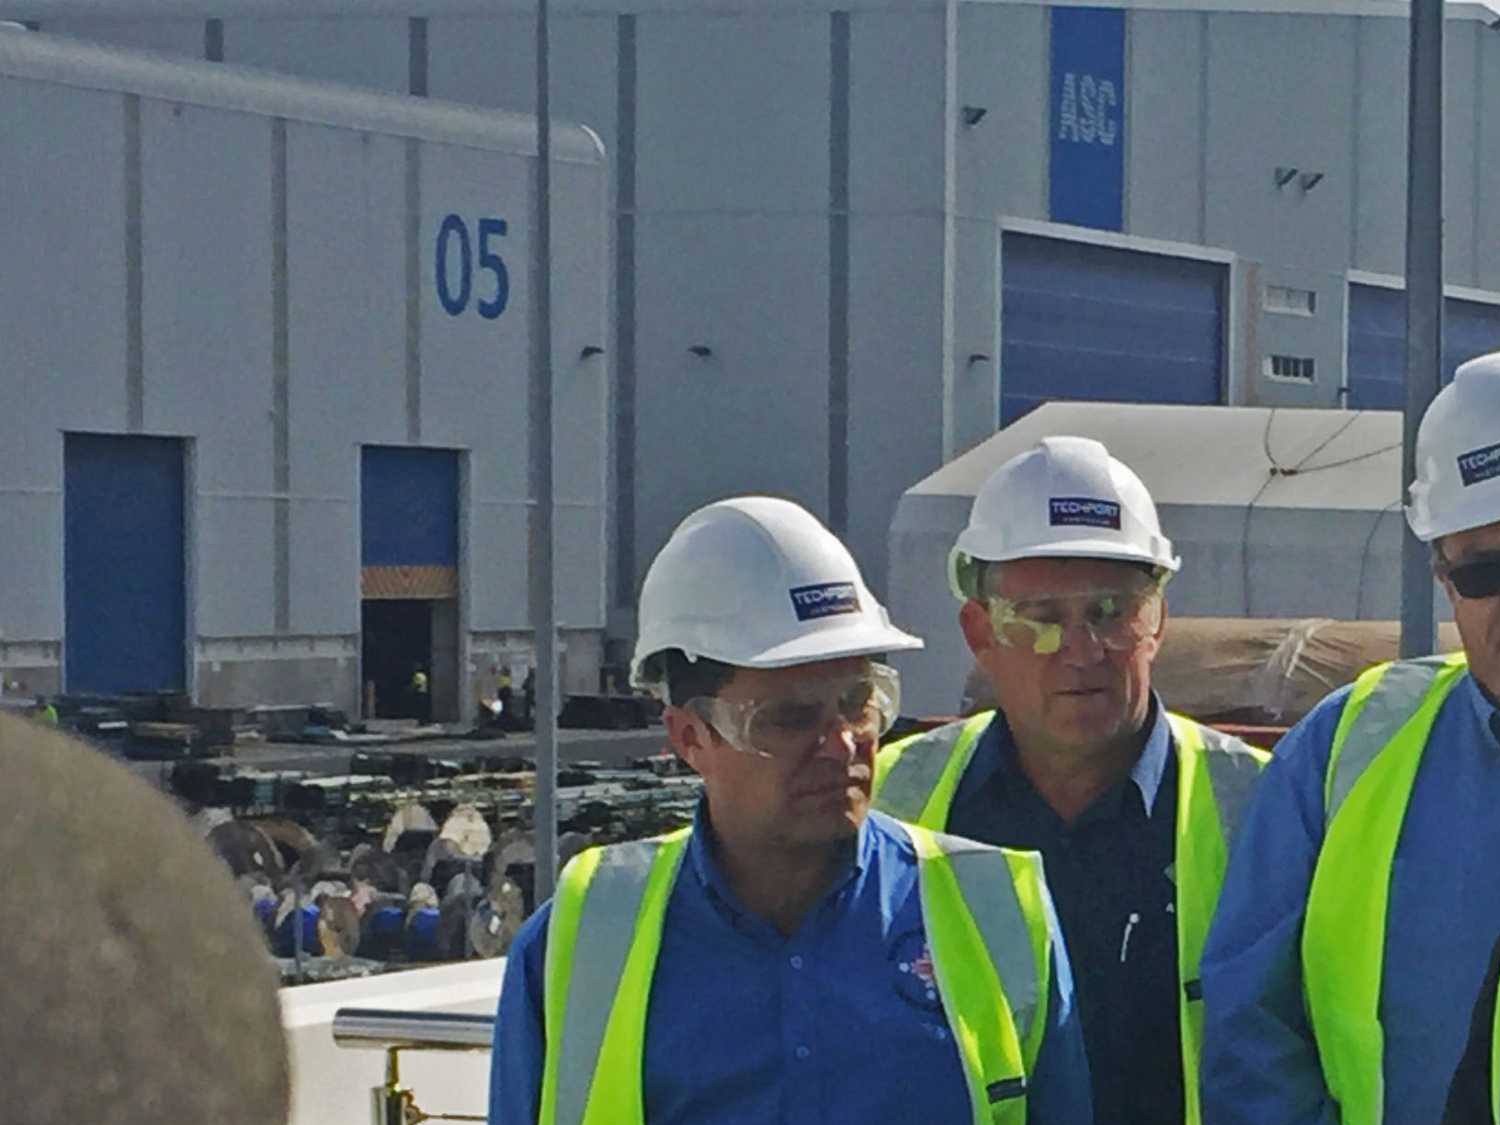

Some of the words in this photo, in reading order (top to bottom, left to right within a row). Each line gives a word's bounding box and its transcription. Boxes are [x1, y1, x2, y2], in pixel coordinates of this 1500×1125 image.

[1058, 72, 1117, 146] ASC
[435, 212, 510, 320] 05
[1051, 501, 1119, 517] TECHPORT
